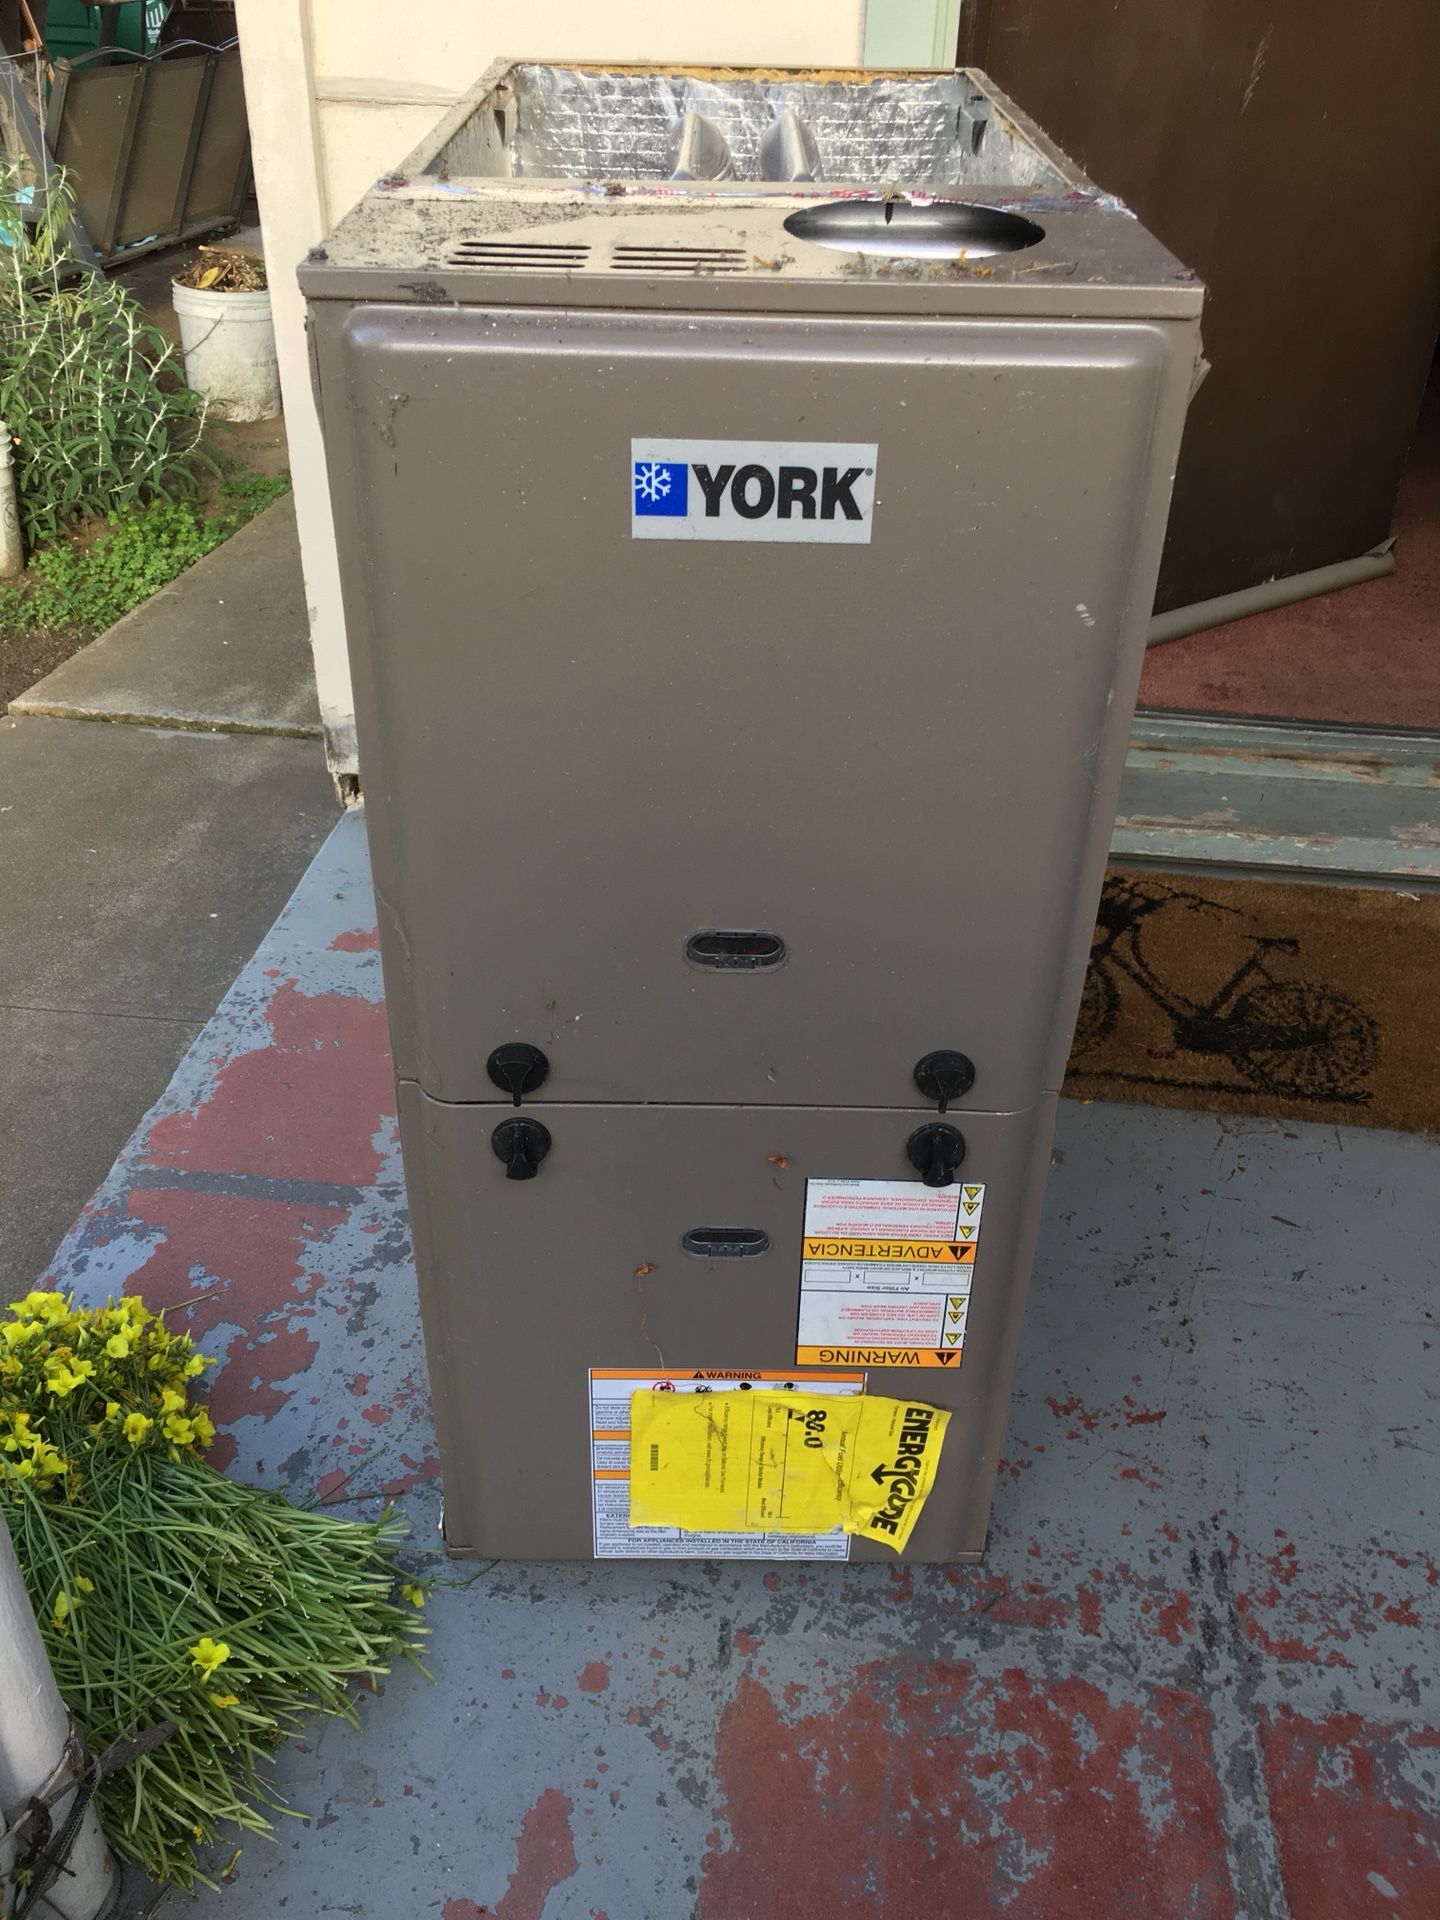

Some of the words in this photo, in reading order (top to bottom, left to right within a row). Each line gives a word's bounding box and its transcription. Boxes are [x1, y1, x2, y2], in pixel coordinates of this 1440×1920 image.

[691, 464, 865, 520] YORK
[809, 1243, 943, 1259] ADVERTENCIA
[819, 1350, 920, 1364] WARNING
[706, 1371, 762, 1379] WARNING
[837, 1449, 846, 1461] Fuel
